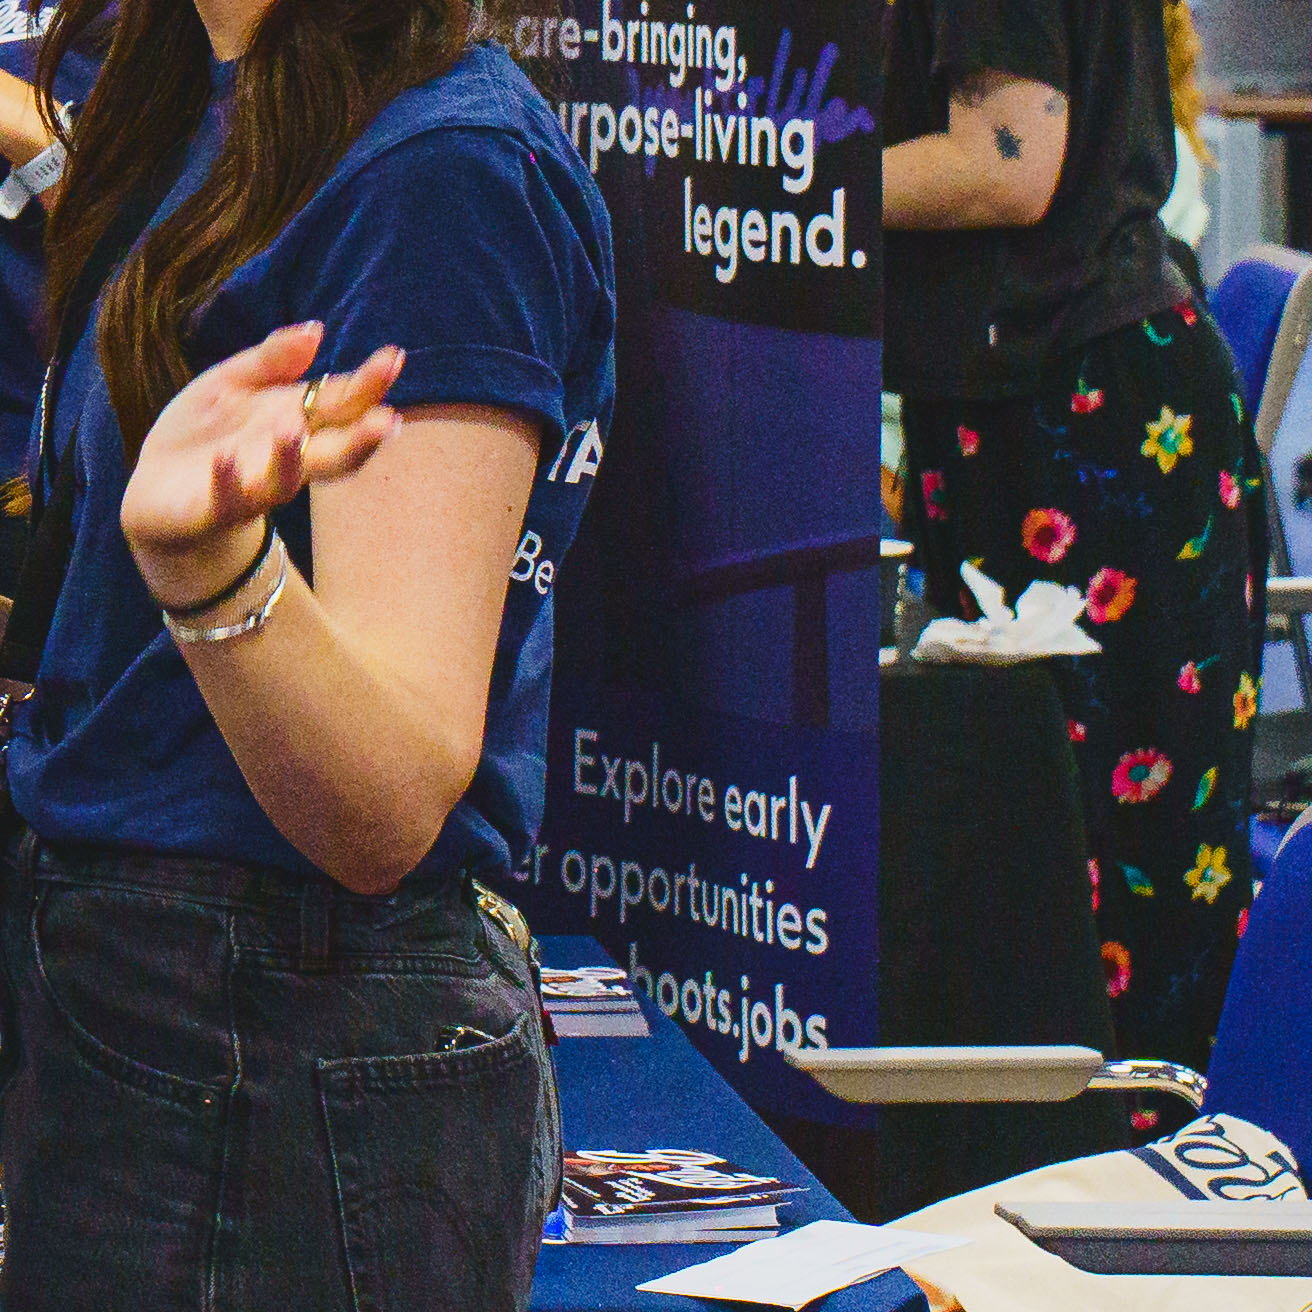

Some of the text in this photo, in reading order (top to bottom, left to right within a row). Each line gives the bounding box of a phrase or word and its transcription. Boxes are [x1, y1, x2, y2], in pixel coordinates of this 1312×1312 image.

[559, 87, 816, 194] rpose-living
[683, 176, 868, 284] legend.
[573, 727, 832, 869] Explore early
[560, 846, 830, 956] opportunities
[629, 941, 829, 1064] boots.jobs
